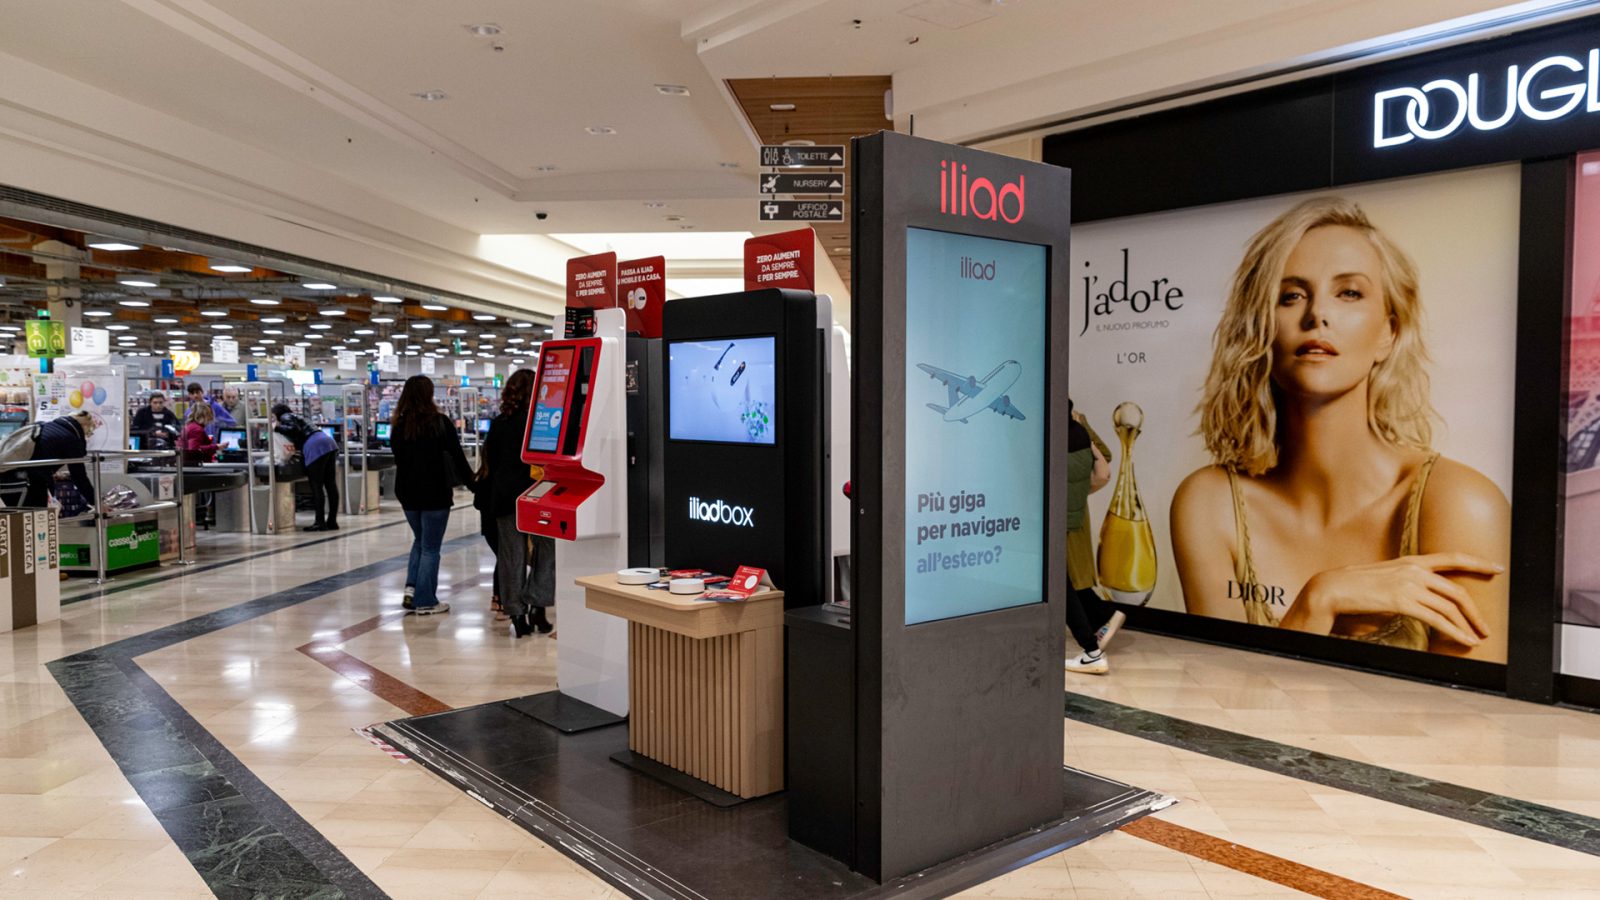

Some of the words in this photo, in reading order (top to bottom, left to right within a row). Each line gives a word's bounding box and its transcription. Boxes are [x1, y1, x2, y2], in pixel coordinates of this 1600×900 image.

[797, 152, 829, 160] TOILETTE
[793, 180, 828, 188] NURSERY
[940, 159, 1025, 224] iliad
[798, 203, 828, 211] UFFICIO
[792, 210, 828, 218] POSTALE
[756, 254, 773, 264] ZERO
[773, 250, 801, 261] AUMENTI
[771, 260, 795, 271] SEMPRE
[960, 256, 996, 281] iliad
[575, 273, 587, 281] ZERO
[587, 270, 607, 279] AUMENTI
[762, 273, 774, 281] PER
[586, 279, 603, 287] SEMPRE
[1079, 248, 1184, 337] j'adore
[1103, 322, 1131, 331] NUOVO
[1132, 319, 1170, 329] PROFUMO
[1117, 352, 1147, 364] L'OR
[917, 492, 945, 513] Più
[949, 489, 986, 514] giga
[689, 496, 754, 527] iliadbox
[917, 523, 947, 545] per
[951, 516, 1021, 537] navigare
[916, 545, 1003, 573] all'estero?
[1227, 580, 1286, 607] DIOR
